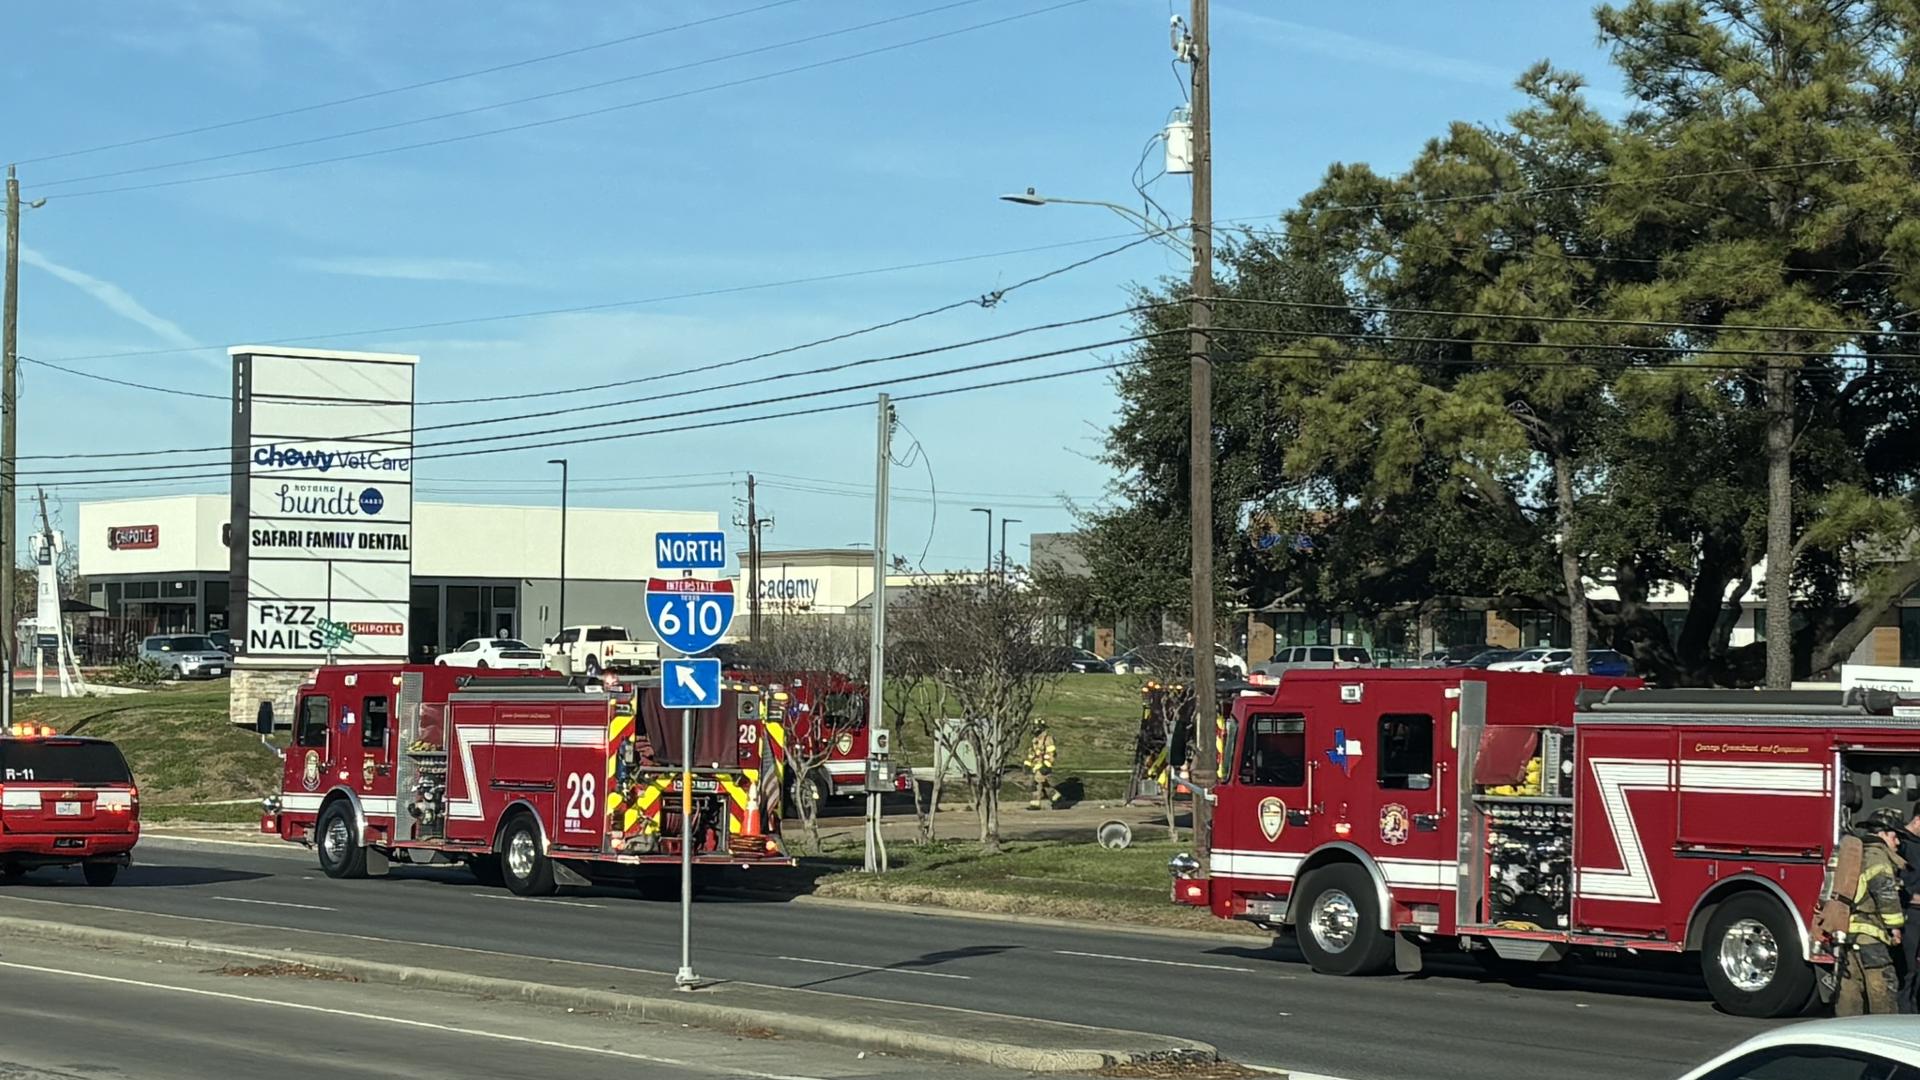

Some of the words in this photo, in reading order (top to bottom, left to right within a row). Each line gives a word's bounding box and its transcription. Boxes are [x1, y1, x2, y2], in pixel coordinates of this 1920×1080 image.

[254, 444, 334, 472] chewy
[294, 484, 336, 493] NOTHING
[275, 484, 358, 515] bundt
[115, 529, 152, 544] CHIPOTLE
[252, 530, 301, 548] SAFARI
[306, 531, 354, 549] FAMILY
[358, 533, 409, 551] DENTAL
[659, 539, 722, 562] NORTH
[666, 581, 714, 592] INTERSTATE
[746, 578, 819, 606] cademy
[658, 600, 722, 636] 610
[251, 629, 323, 650] NAILS
[350, 624, 402, 634] CHIPOTLE
[739, 724, 757, 744] 28
[5, 768, 35, 780] R-11
[565, 772, 596, 819] 28
